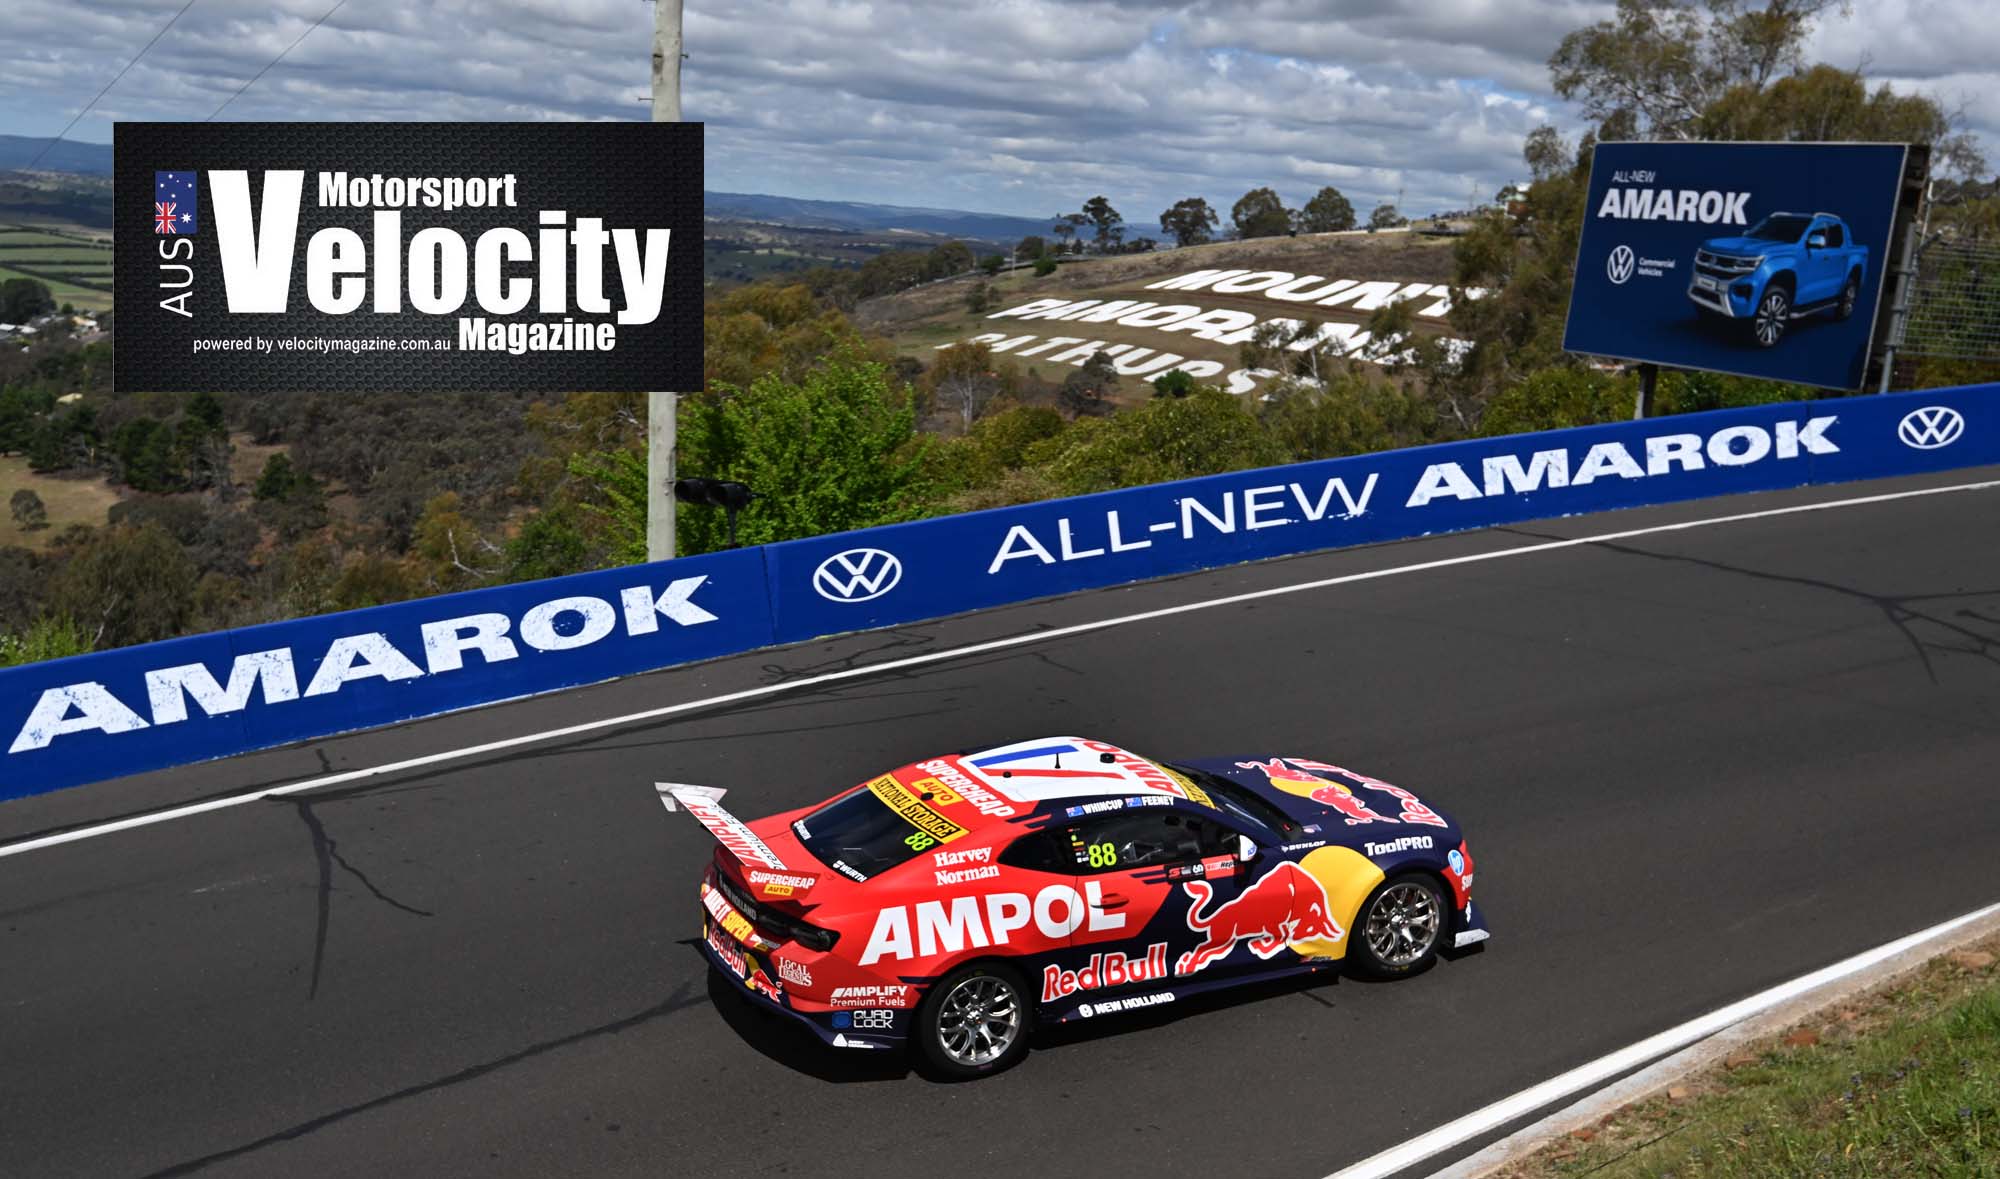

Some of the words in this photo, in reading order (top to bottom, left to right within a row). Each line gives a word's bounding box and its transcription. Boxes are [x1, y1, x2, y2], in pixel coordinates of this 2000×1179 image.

[1612, 170, 1656, 183] ALL-NEW
[1597, 188, 1751, 225] AMAROK
[1405, 416, 1840, 507] AMAROK
[987, 473, 1379, 574] ALL-NEW
[8, 575, 719, 753] AMAROK
[1069, 738, 1183, 796] AMPO
[915, 759, 1015, 817] SUPERCHEAP
[920, 781, 954, 802] AUTO
[873, 777, 909, 808] NATIONAL
[902, 804, 959, 838] STORAGE
[1082, 799, 1124, 814] WHINCUP
[1142, 796, 1174, 806] FEENEY
[904, 832, 935, 851] 88
[1288, 840, 1326, 851] DUNLOP
[1364, 835, 1433, 857] ToolPRO
[934, 847, 992, 867] Harvey
[1088, 842, 1117, 868] 88
[749, 870, 815, 889] SUPERCHEAP
[934, 864, 1000, 886] Norman
[767, 884, 790, 894] AUTO
[858, 880, 1126, 966] AMPOL
[780, 957, 811, 976] LOCAL
[1041, 953, 1102, 1002] Red
[1102, 942, 1168, 986] Bull
[830, 997, 875, 1007] Premium
[878, 997, 906, 1007] Fuels
[842, 986, 908, 997] AMPLIFY
[1095, 1002, 1123, 1014] NEW
[1124, 992, 1175, 1011] HOLLAND
[853, 1010, 894, 1020] QUAD
[853, 1019, 893, 1029] LOCK
